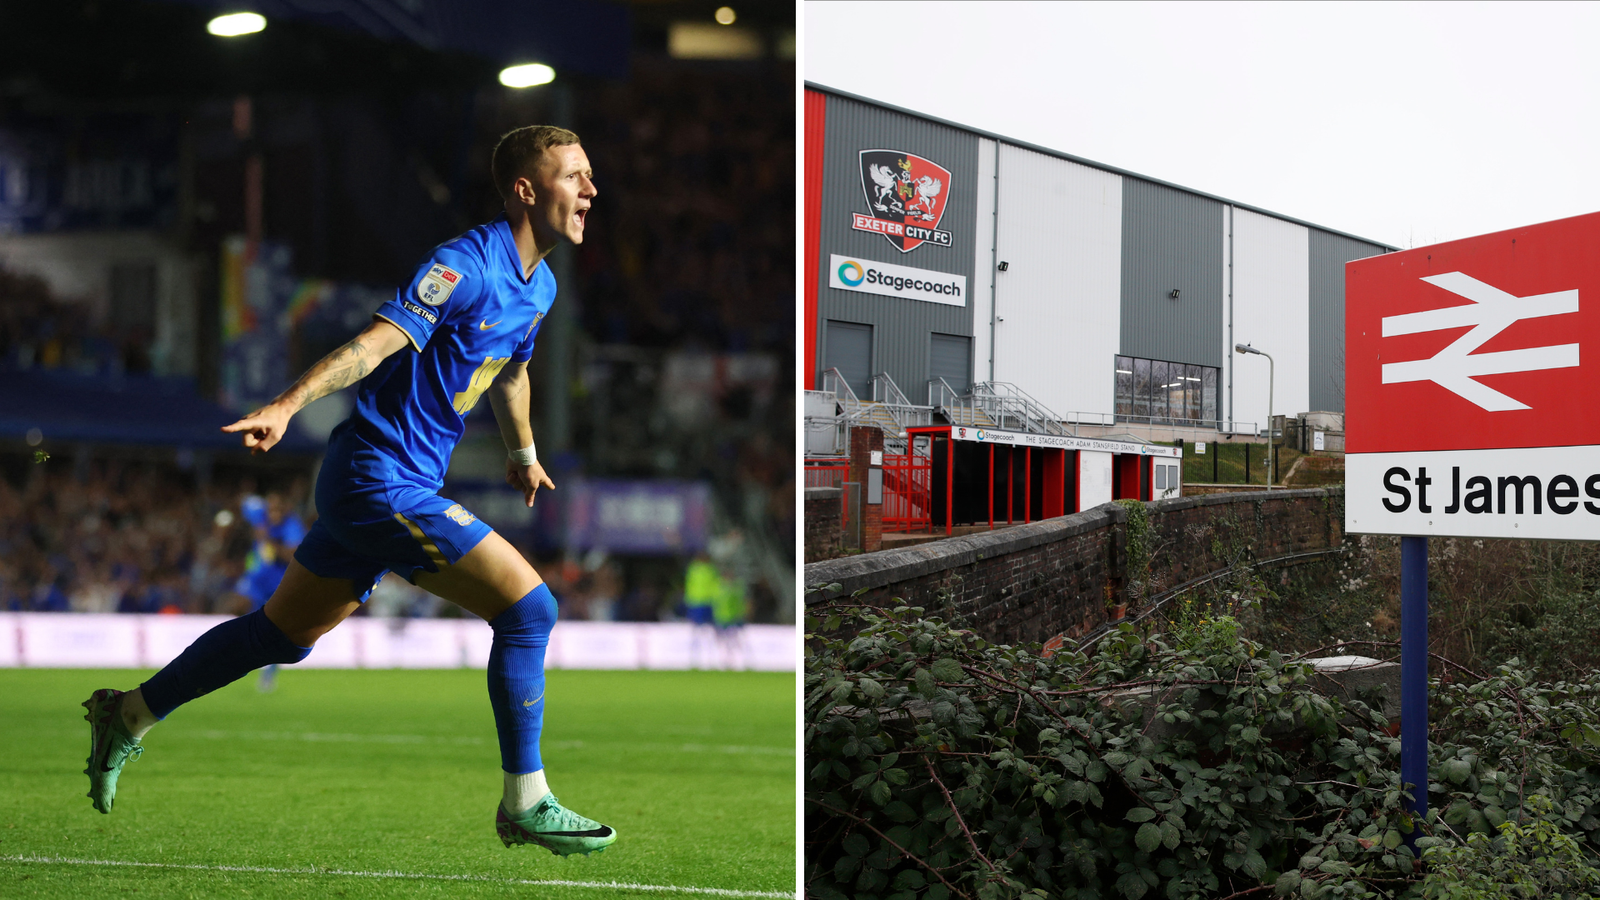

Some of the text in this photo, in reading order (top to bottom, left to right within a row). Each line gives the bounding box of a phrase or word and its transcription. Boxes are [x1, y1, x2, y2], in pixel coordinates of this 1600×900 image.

[856, 217, 949, 243] EXETER CITY FC
[432, 266, 444, 275] sky
[443, 271, 457, 283] bet
[866, 268, 961, 297] Stagecoach
[423, 292, 434, 302] EFL
[403, 300, 438, 325] TOGETHER
[985, 431, 1015, 441] Stagecoach
[1025, 435, 1136, 452] THE STAGECOACH ADAM STANSFIELD STAND
[1381, 466, 1600, 515] St James
